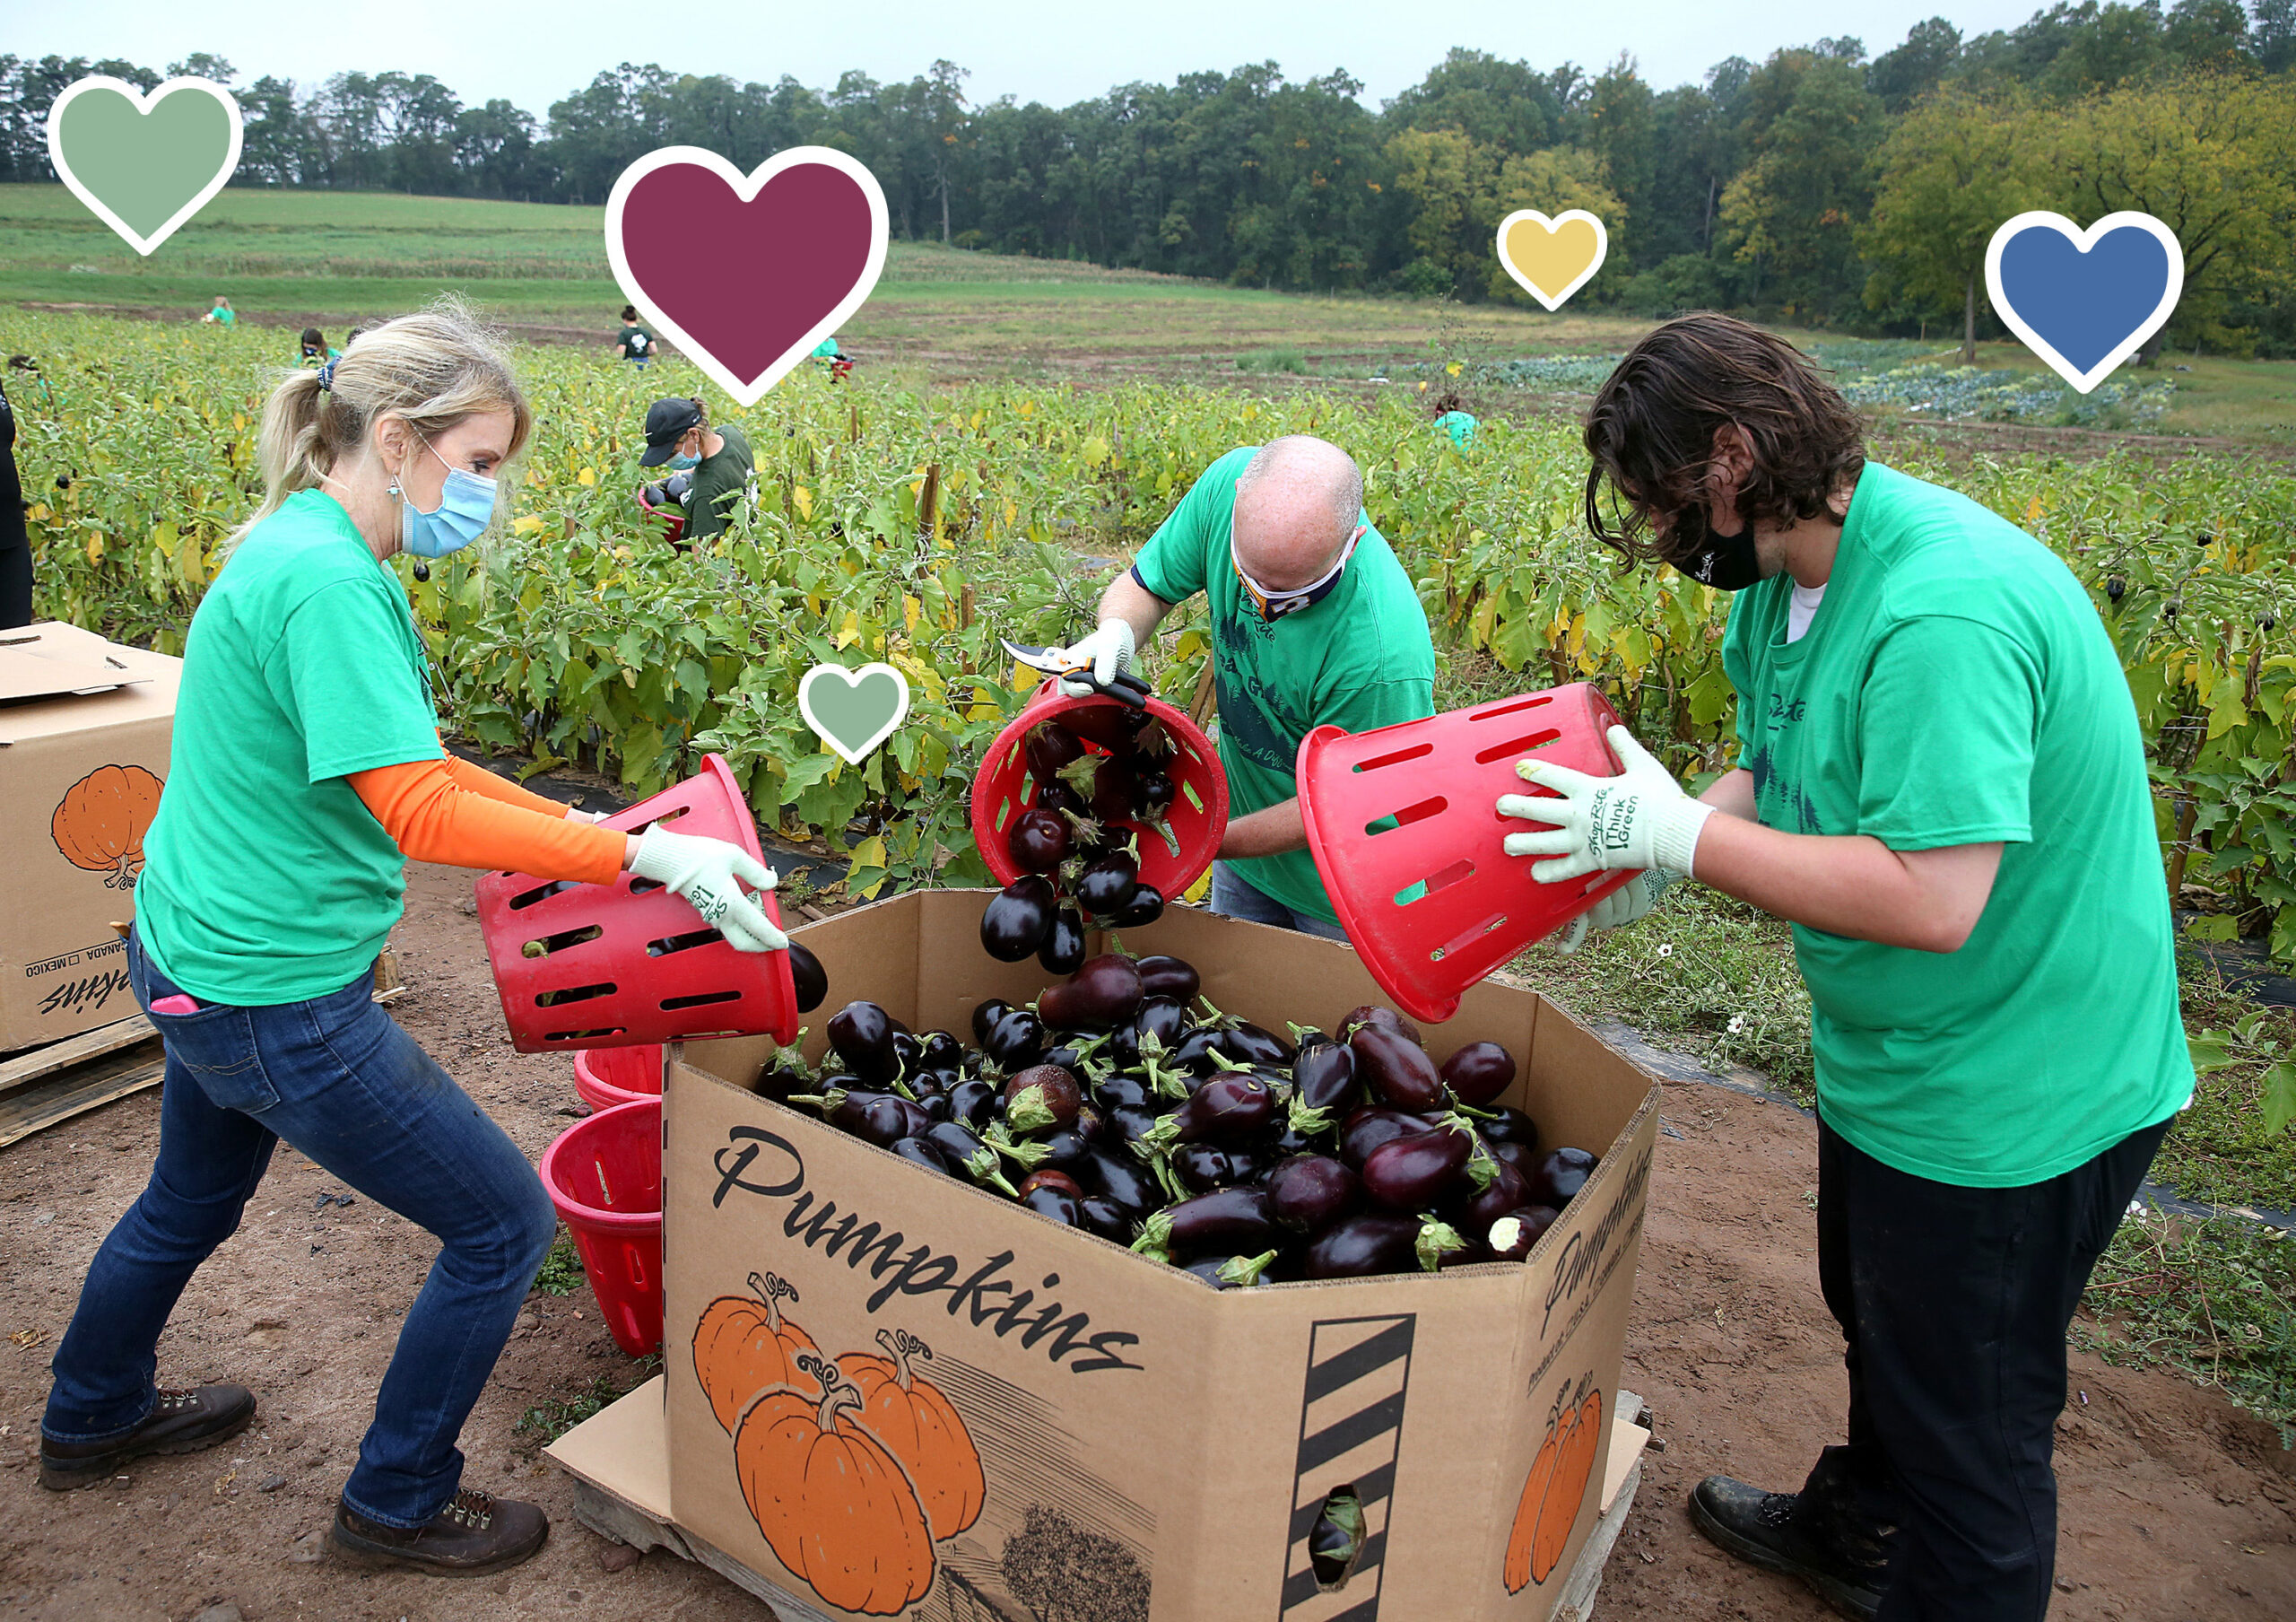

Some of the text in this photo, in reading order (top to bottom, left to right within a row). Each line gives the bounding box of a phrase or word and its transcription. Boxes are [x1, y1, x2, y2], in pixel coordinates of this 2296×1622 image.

[1606, 798, 1626, 841] Think
[1618, 795, 1639, 842] Green
[25, 959, 67, 978] MEXICO
[714, 1125, 1144, 1373] Pumpkins
[1540, 1145, 1652, 1341] Pumpkins
